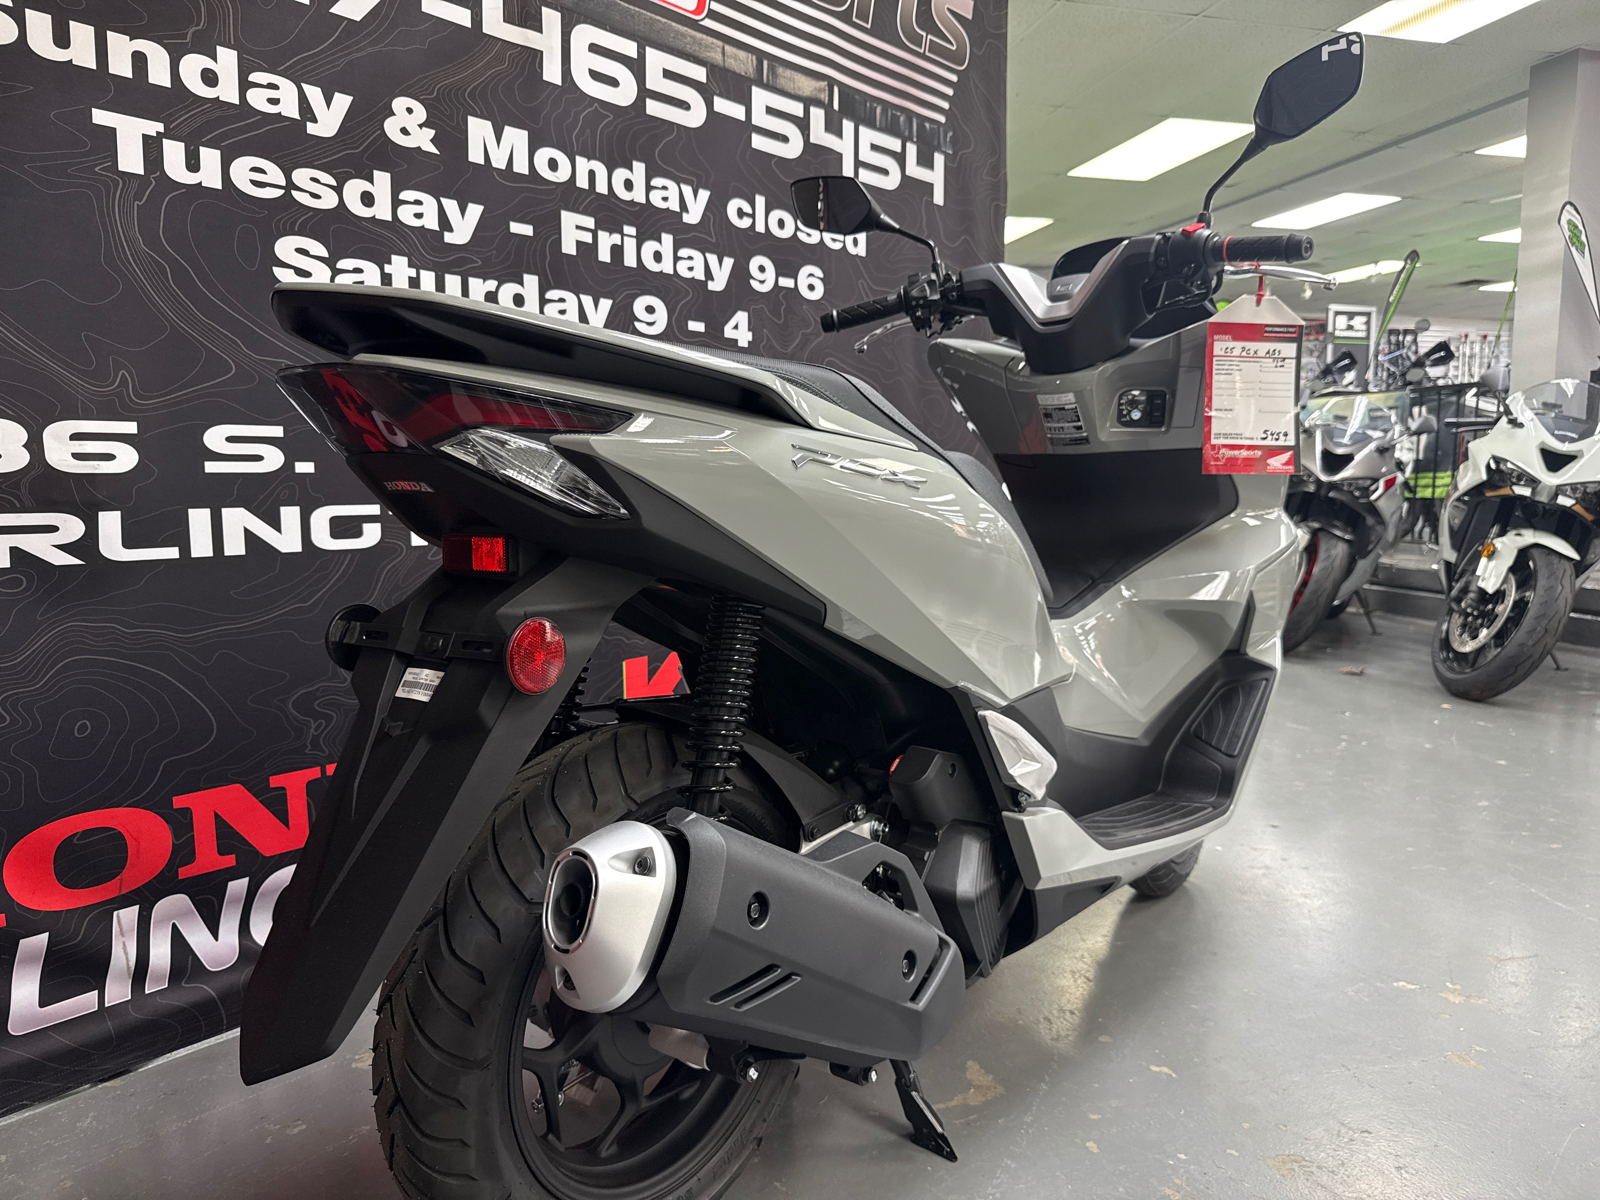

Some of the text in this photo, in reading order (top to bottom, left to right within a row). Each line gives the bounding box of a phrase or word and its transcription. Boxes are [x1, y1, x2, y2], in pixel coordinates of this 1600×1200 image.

[0, 9, 353, 138] unday
[383, 96, 441, 155] &
[467, 115, 711, 226] Monday
[91, 107, 485, 245] Tuesday
[560, 209, 735, 293] Friday
[748, 254, 826, 302] 9-6
[632, 295, 669, 336] 9
[722, 310, 753, 348] 4
[1239, 346, 1259, 356] PCX
[202, 424, 316, 474] S.
[383, 481, 434, 493] HONDA
